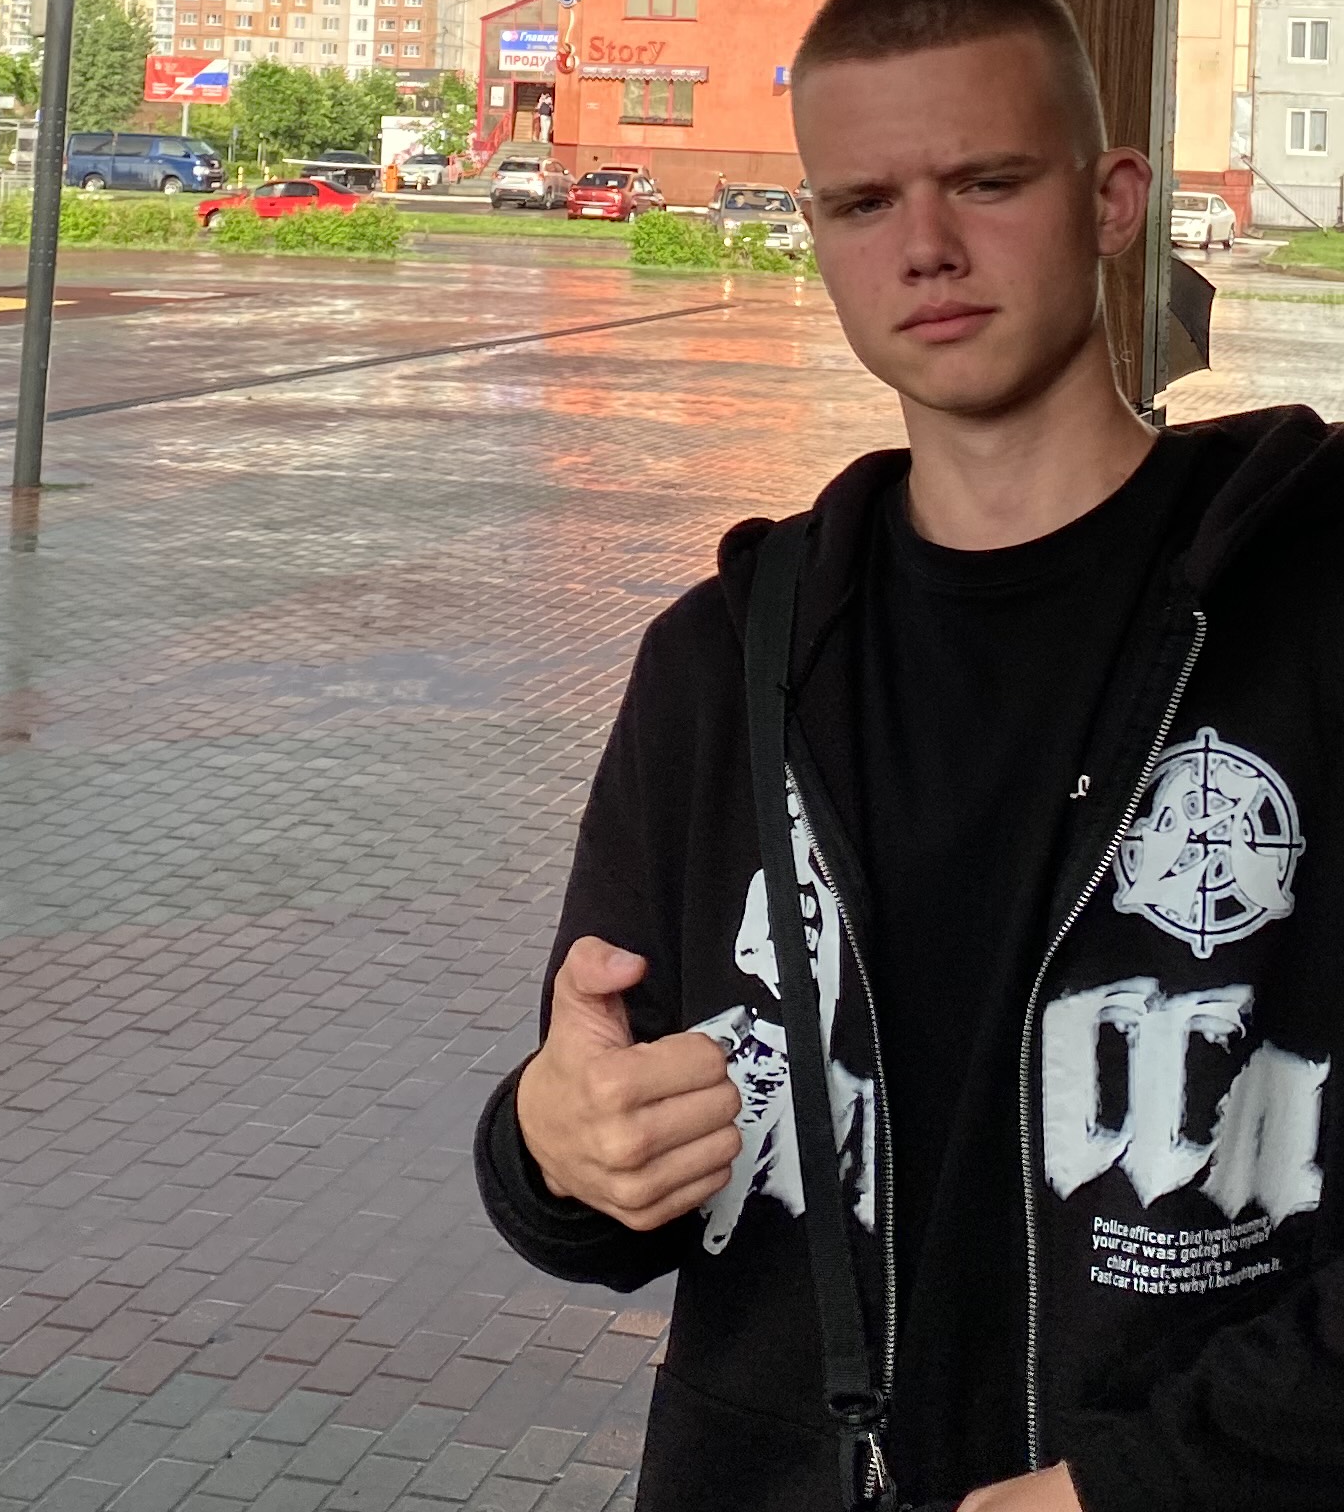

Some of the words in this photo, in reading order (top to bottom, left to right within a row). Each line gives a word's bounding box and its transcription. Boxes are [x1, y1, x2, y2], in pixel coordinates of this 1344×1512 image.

[1092, 1234, 1122, 1251] your
[1142, 1245, 1177, 1261] was
[1179, 1243, 1221, 1264] going
[1090, 1266, 1113, 1285] Fast
[1112, 1274, 1131, 1290] car
[1132, 1276, 1178, 1295] that's
[1179, 1277, 1208, 1295] why
